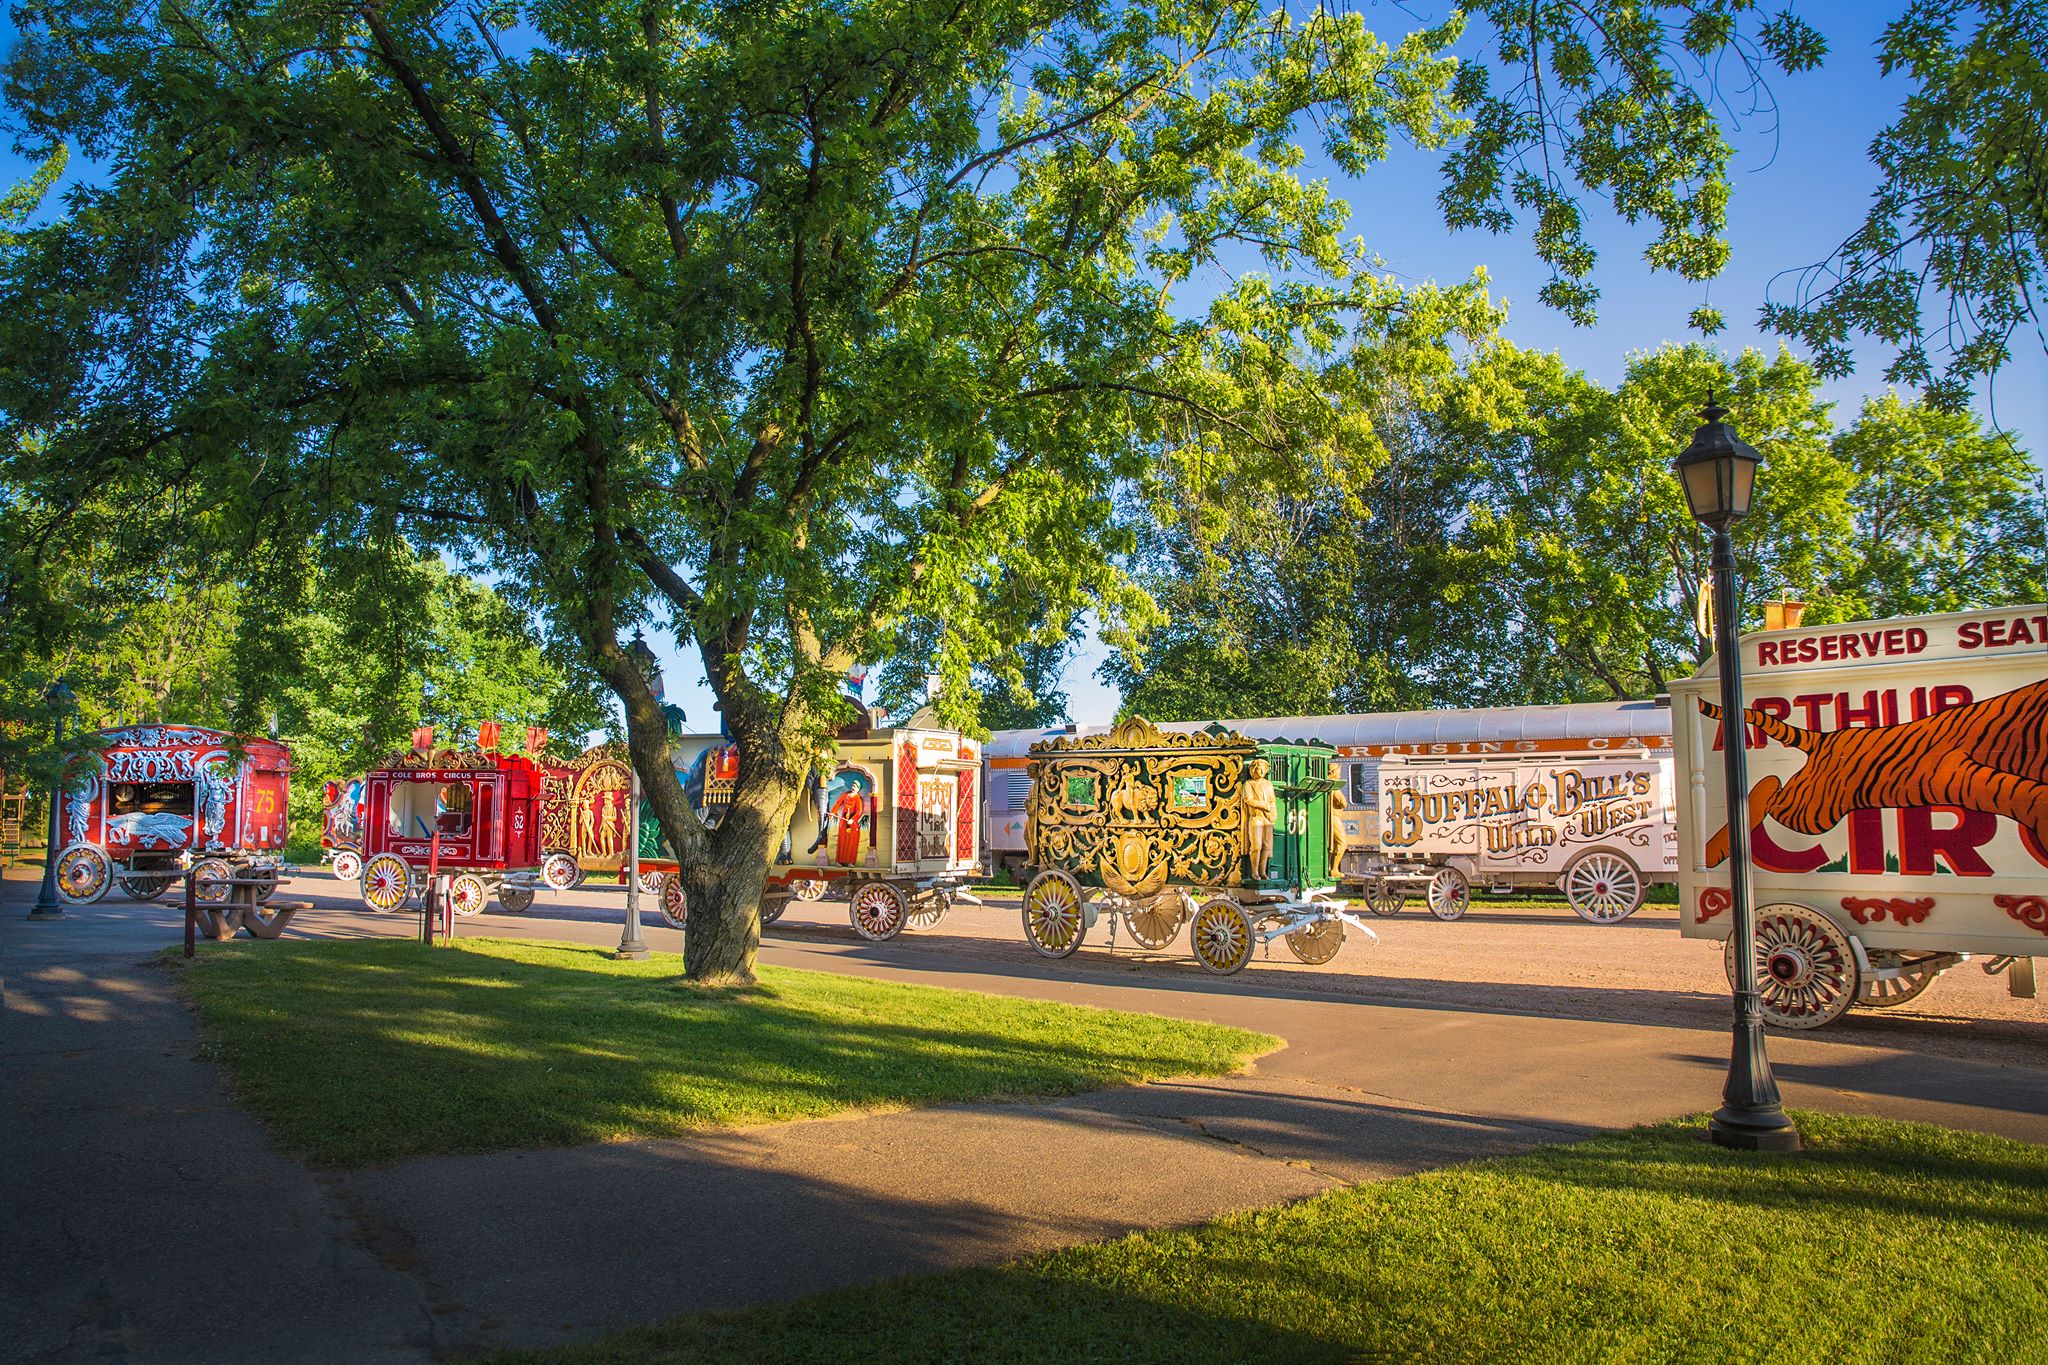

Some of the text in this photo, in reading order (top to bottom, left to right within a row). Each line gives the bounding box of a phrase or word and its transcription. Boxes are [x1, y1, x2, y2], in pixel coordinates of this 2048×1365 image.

[1759, 628, 1928, 667] RESERVED
[256, 788, 275, 814] 75
[1381, 769, 1651, 847] BUFFALO BILL'S
[1486, 800, 1653, 853] WILD WEST
[1663, 855, 1678, 865] OFF
